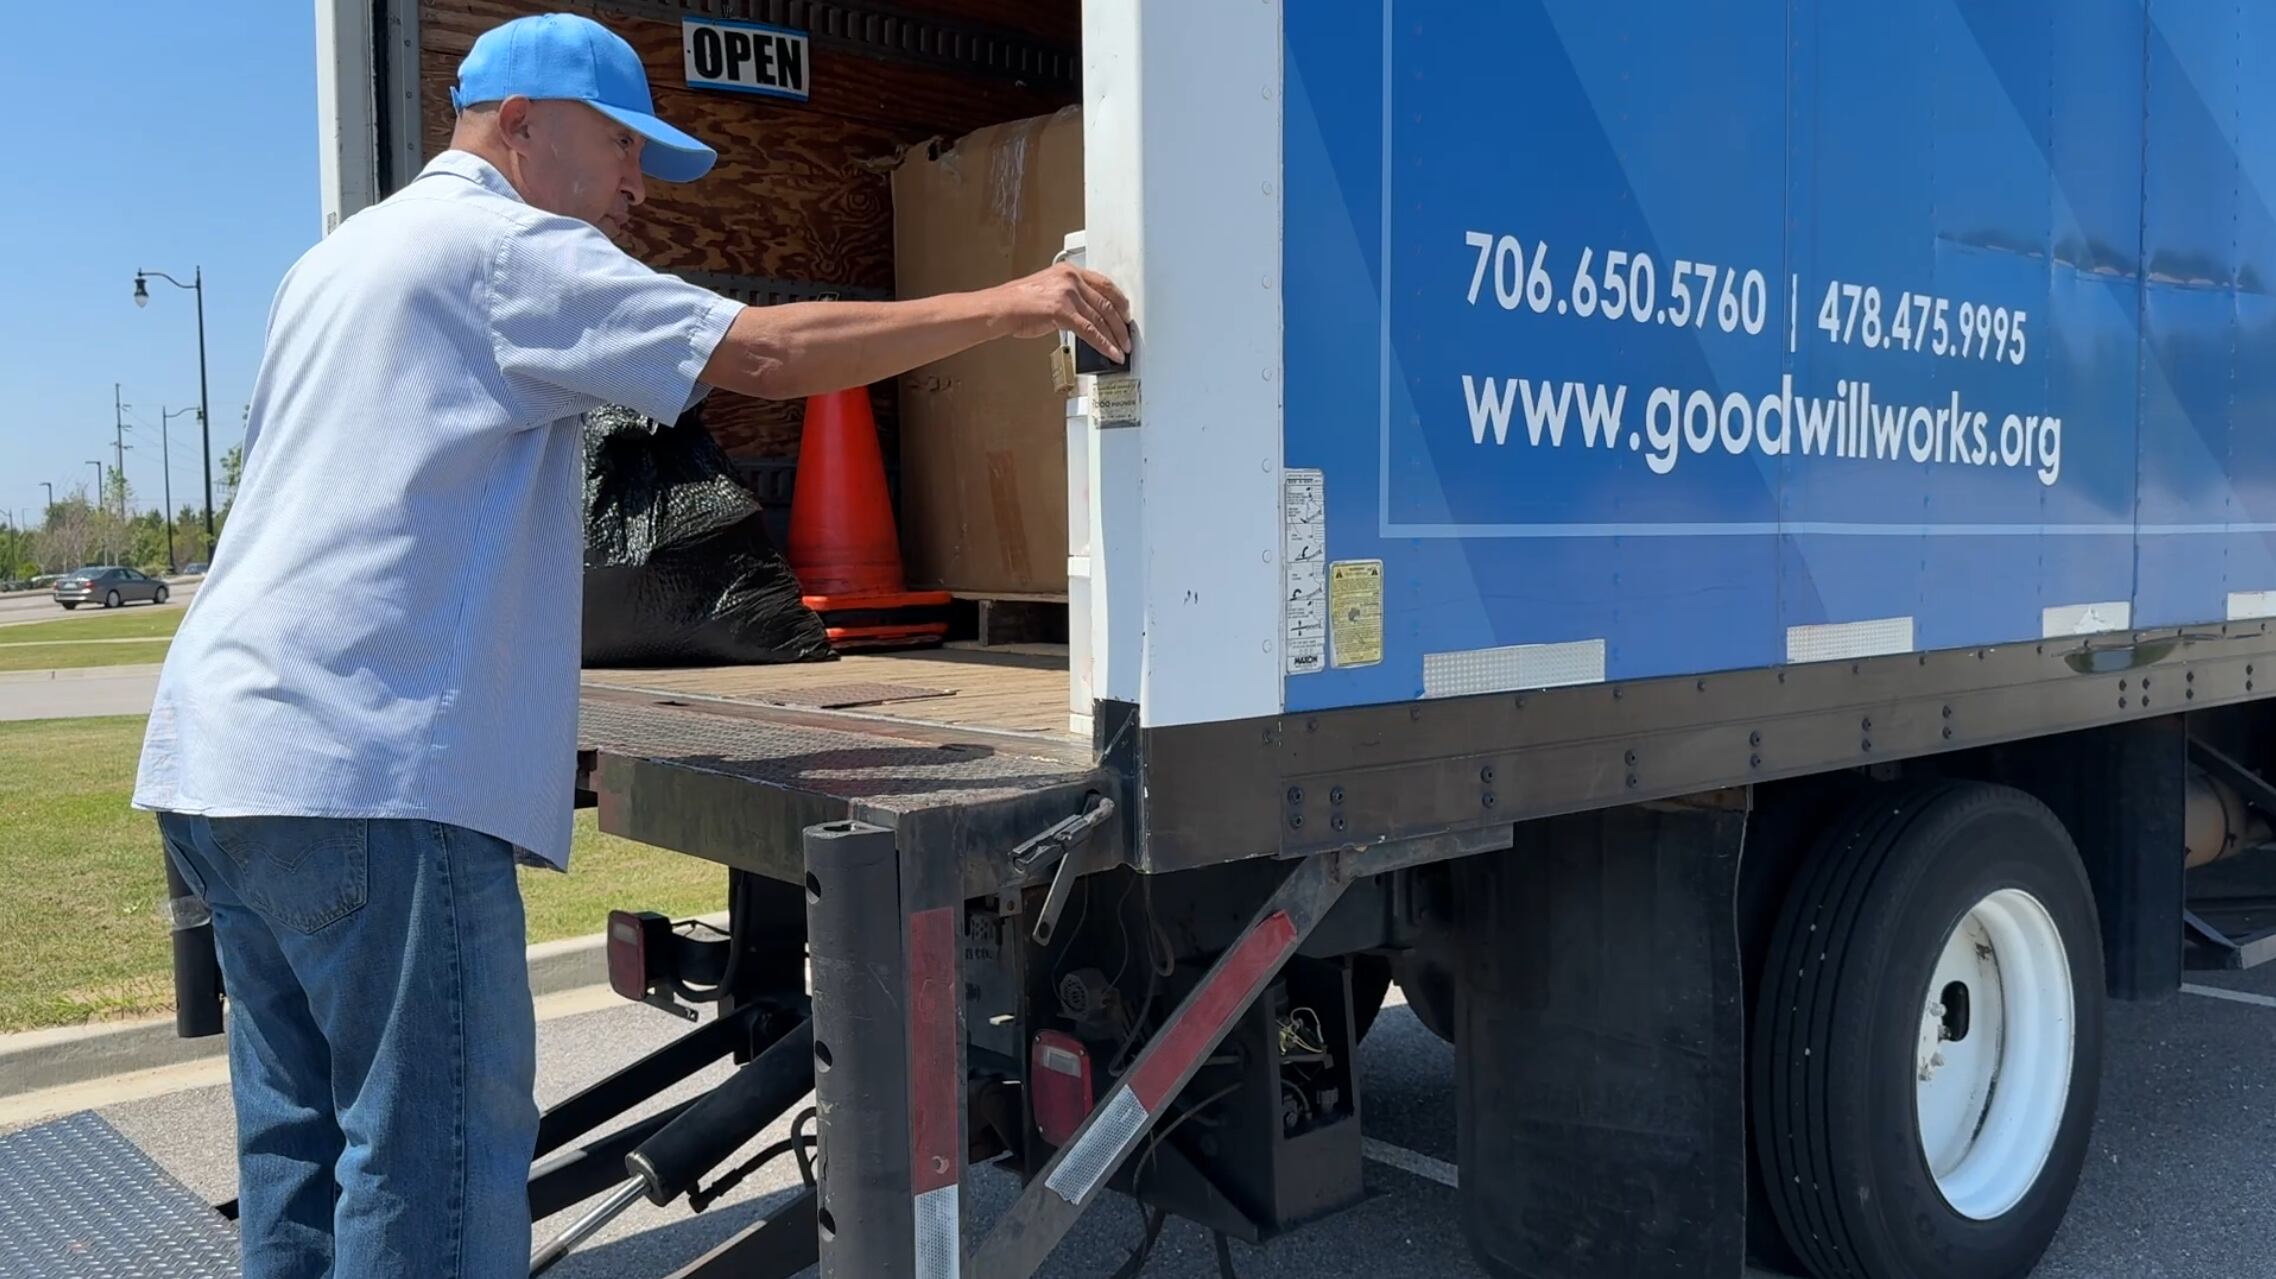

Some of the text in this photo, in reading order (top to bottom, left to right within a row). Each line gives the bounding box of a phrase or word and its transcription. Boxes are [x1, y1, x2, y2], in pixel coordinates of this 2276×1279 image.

[693, 27, 802, 90] OPEN
[1466, 231, 1767, 335] 706.650.5760
[1818, 280, 2027, 365] 478.475.9995
[1462, 375, 2062, 490] www.goodwillworks.org
